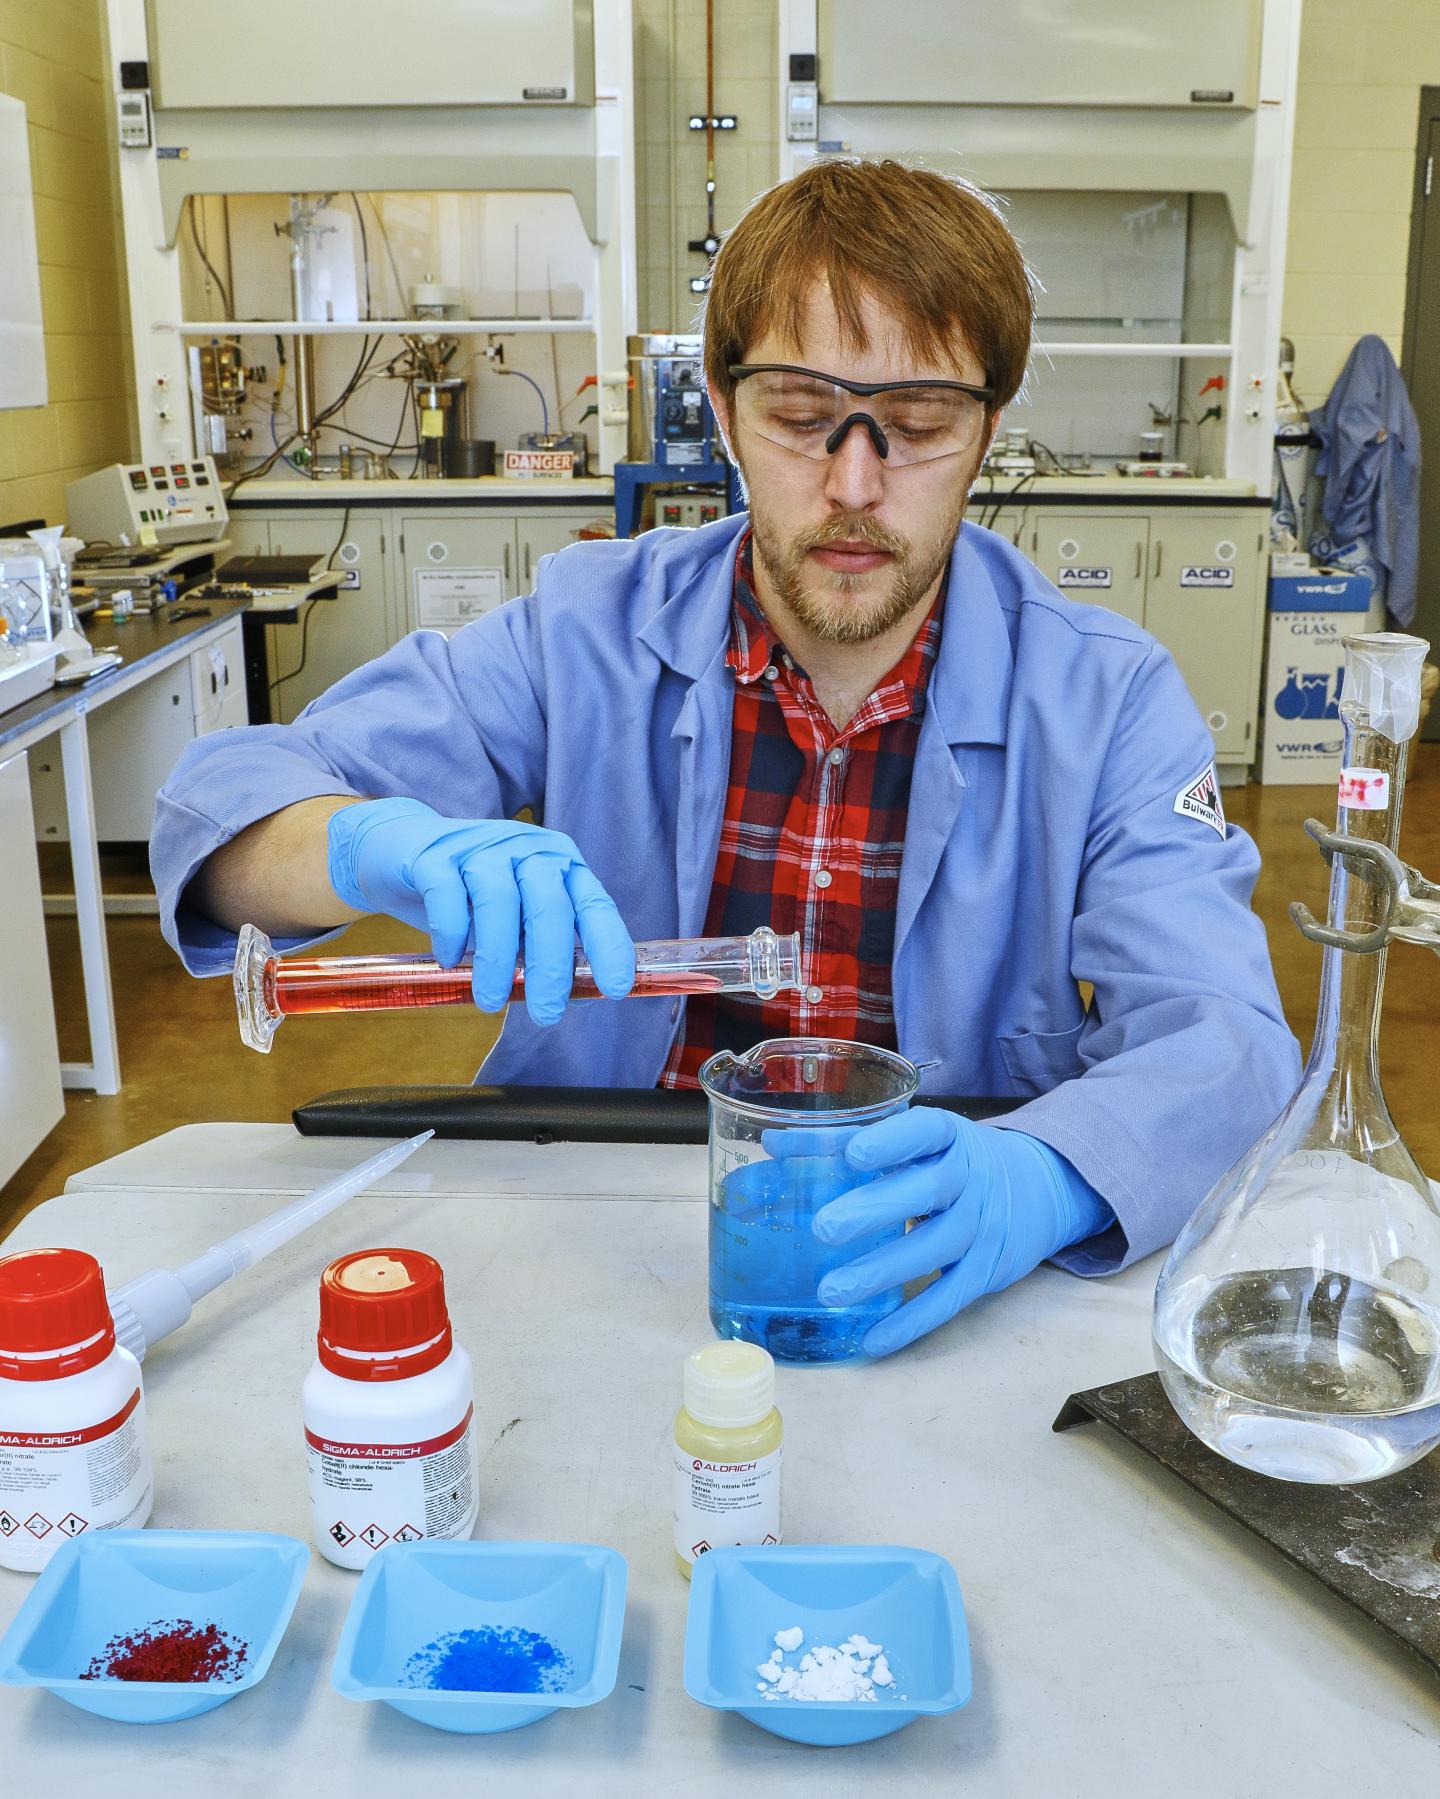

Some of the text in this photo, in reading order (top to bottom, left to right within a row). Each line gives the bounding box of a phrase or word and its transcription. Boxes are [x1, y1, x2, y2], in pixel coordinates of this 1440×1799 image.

[509, 454, 571, 469] DANGER
[1063, 569, 1109, 580] ACID
[1185, 568, 1231, 579] ACID
[1290, 623, 1338, 636] GLASS
[1276, 743, 1312, 753] VWR
[734, 1151, 749, 1164] 500
[322, 1443, 421, 1457] SIGMA-ALDRICH
[704, 1462, 757, 1473] ALDRICH
